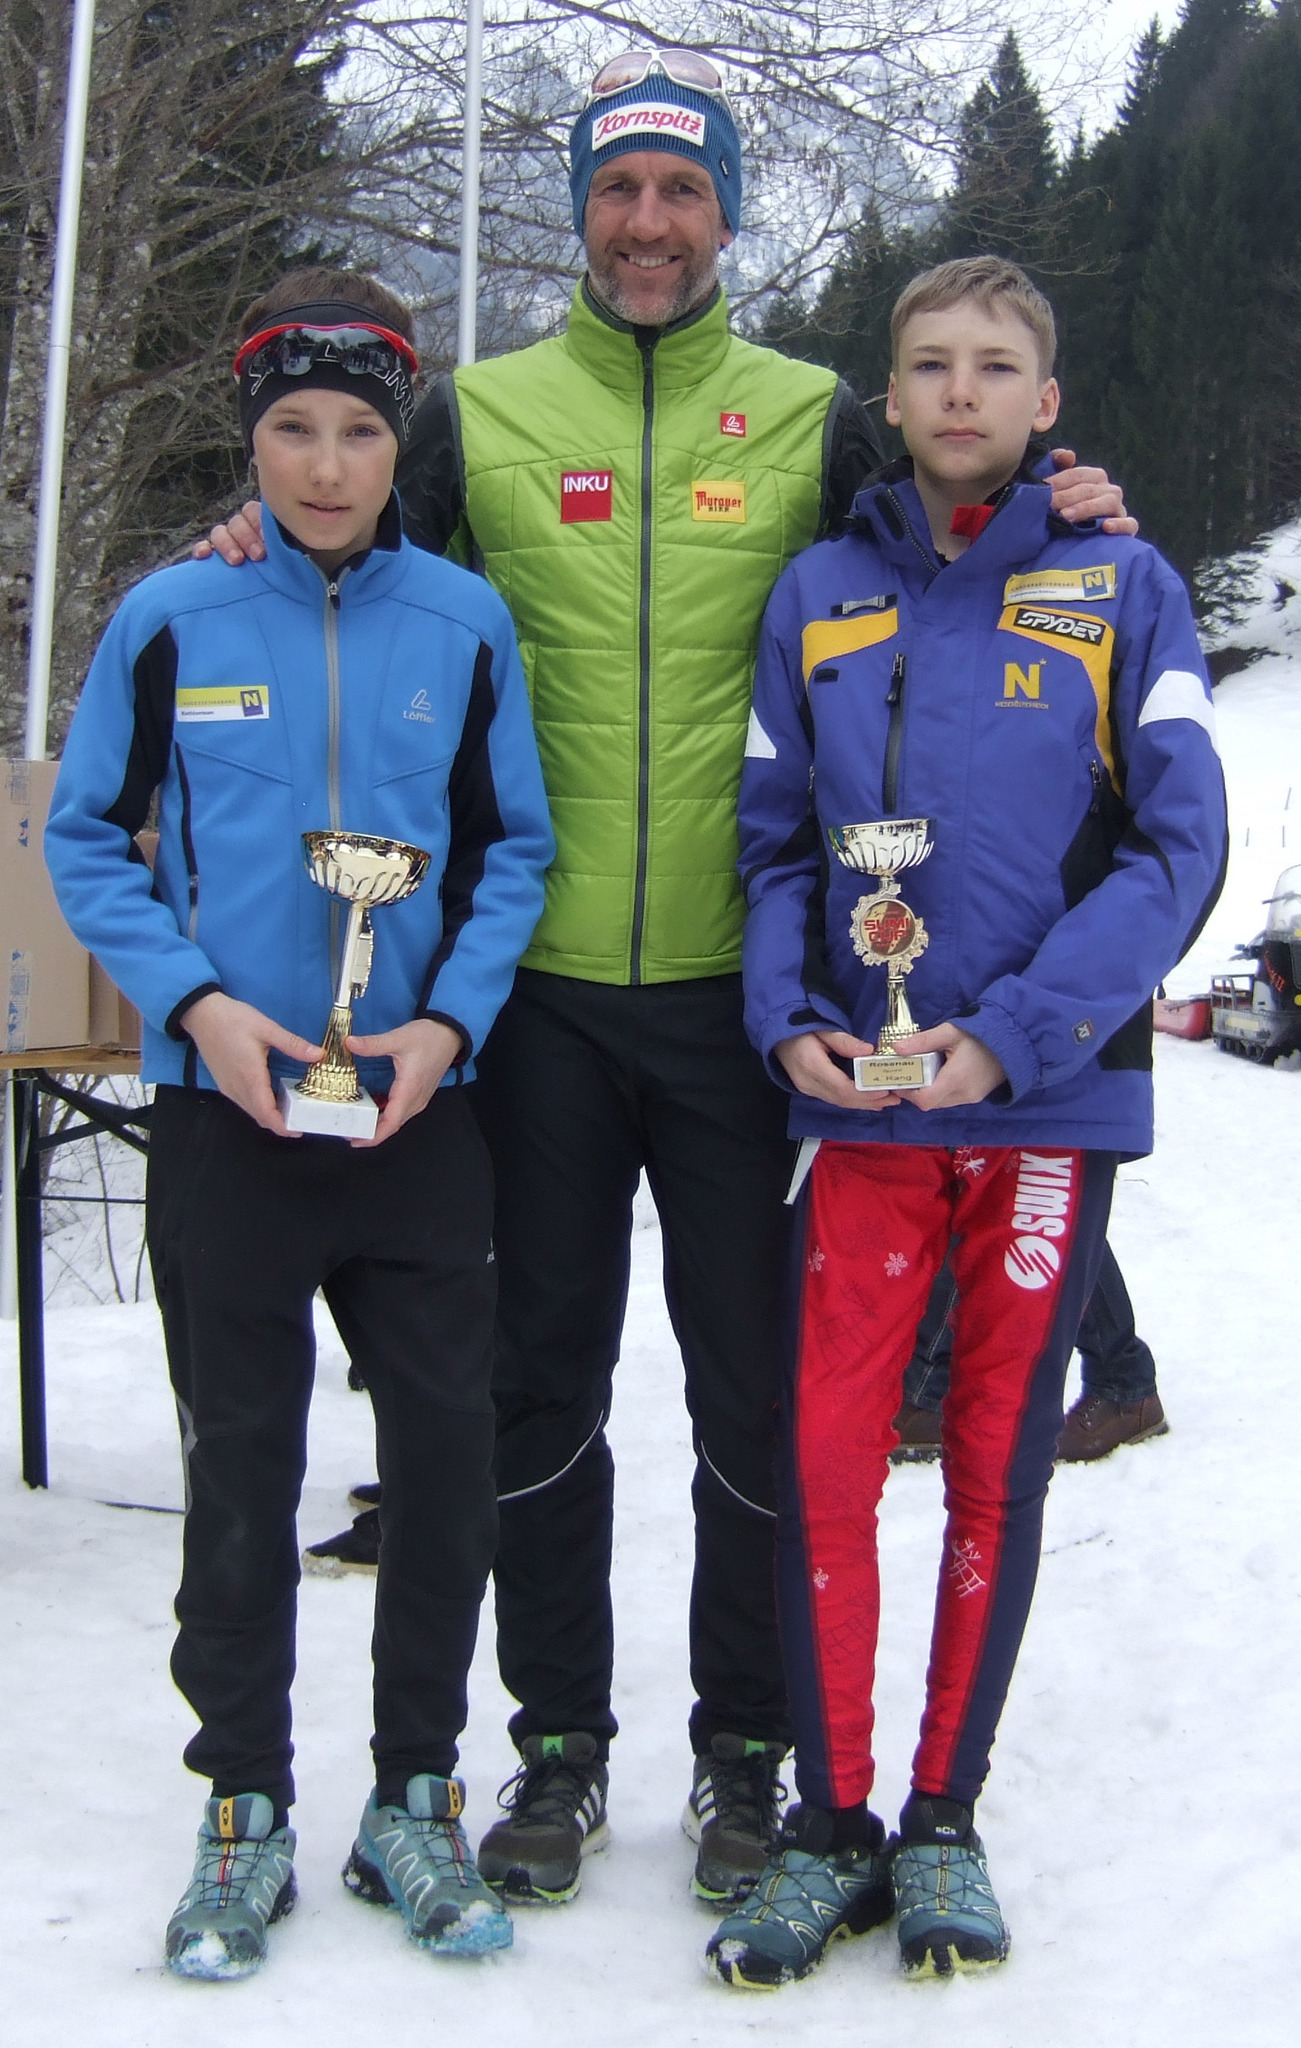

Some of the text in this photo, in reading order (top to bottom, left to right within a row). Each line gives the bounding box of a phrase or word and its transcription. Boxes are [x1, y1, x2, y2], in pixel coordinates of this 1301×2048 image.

[594, 111, 702, 142] Kornspitz
[563, 475, 608, 493] INKU
[695, 491, 742, 511] Murauer
[1085, 573, 1104, 589] N
[1017, 611, 1102, 642] SPYDER
[1004, 662, 1041, 699] N
[243, 692, 260, 708] N
[864, 917, 910, 931] SUMI
[868, 930, 907, 943] CUP
[1011, 1151, 1073, 1237] SWIX
